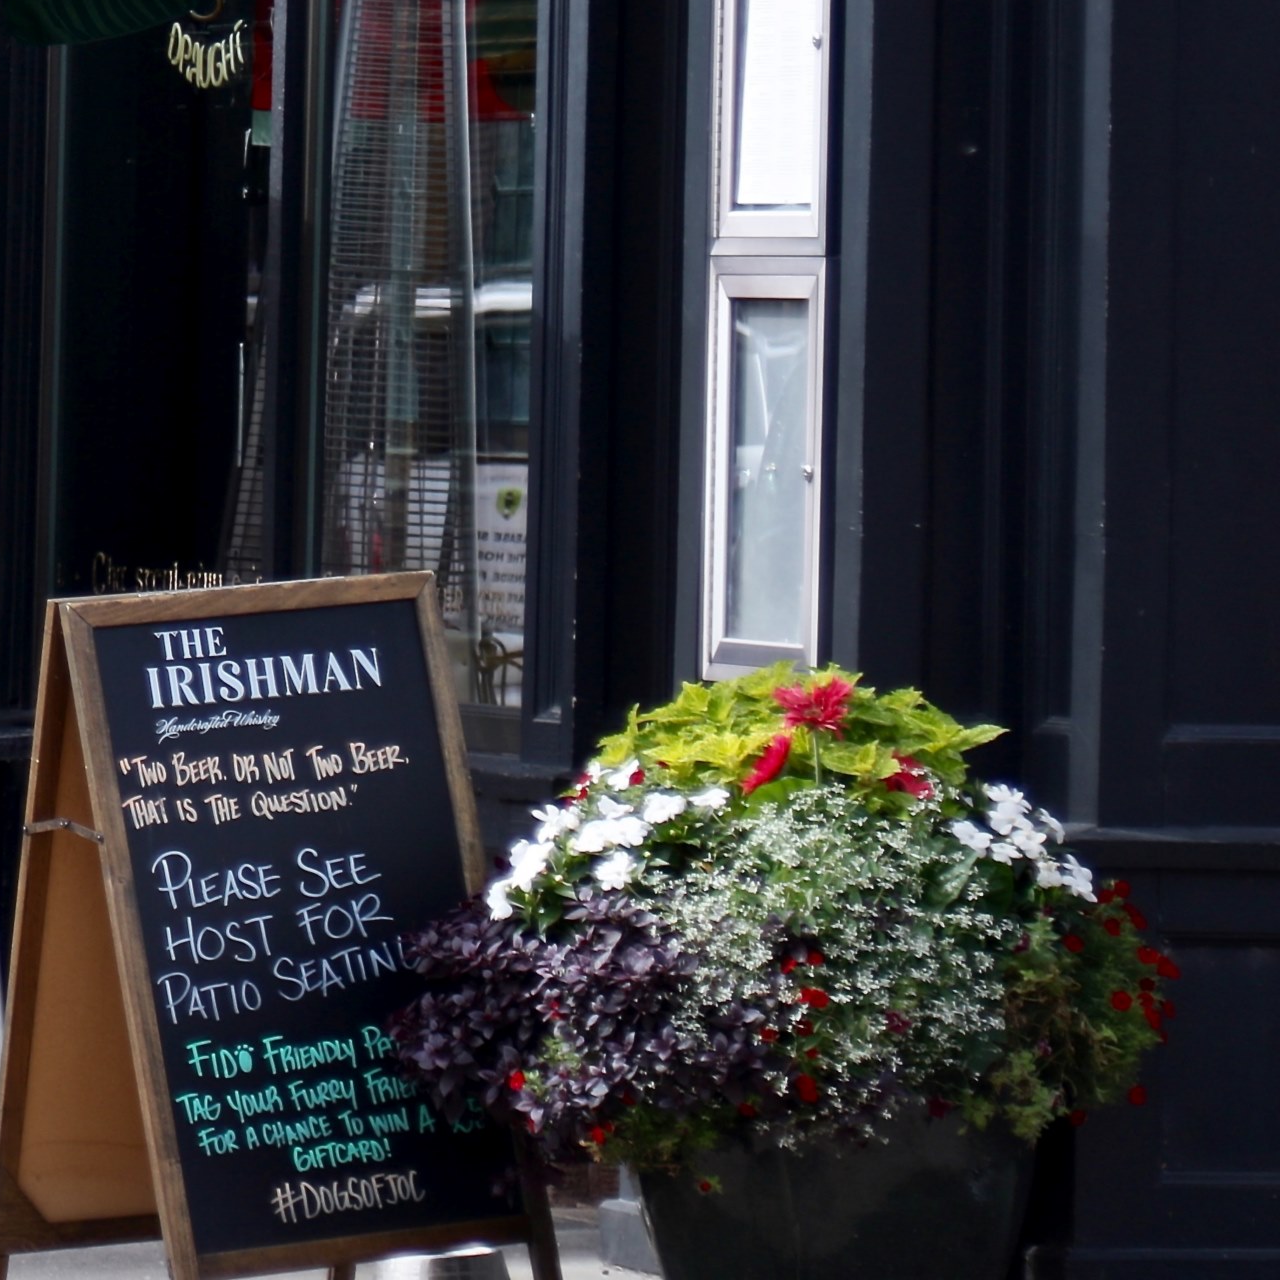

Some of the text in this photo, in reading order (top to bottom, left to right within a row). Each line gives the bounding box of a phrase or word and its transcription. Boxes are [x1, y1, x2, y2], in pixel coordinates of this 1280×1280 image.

[167, 19, 248, 90] DRAUGHT
[154, 626, 228, 661] THE
[146, 647, 382, 709] IRISHMAN
[156, 709, 280, 744] Handcrafted Whiskey
[234, 753, 260, 784] OR
[263, 748, 294, 784] NOT
[306, 744, 342, 778] TWO
[122, 794, 168, 830] THAT
[176, 798, 198, 822] IS
[204, 794, 240, 825] THE
[151, 847, 382, 910] PLEASE SEE
[165, 893, 394, 964] HOST FOR
[156, 972, 262, 1024] PATIO
[262, 1035, 356, 1076] FRIENDLY
[176, 1092, 220, 1125] TAG
[227, 1085, 283, 1123] YOUR
[290, 1080, 356, 1112] FURRY
[198, 1127, 240, 1156] FOR
[246, 1126, 260, 1150] A
[262, 1116, 332, 1149] CHANCE
[338, 1110, 364, 1136] TO
[370, 1107, 408, 1138] WIN
[418, 1104, 436, 1134] A
[292, 1138, 392, 1173] GIFTCARD!
